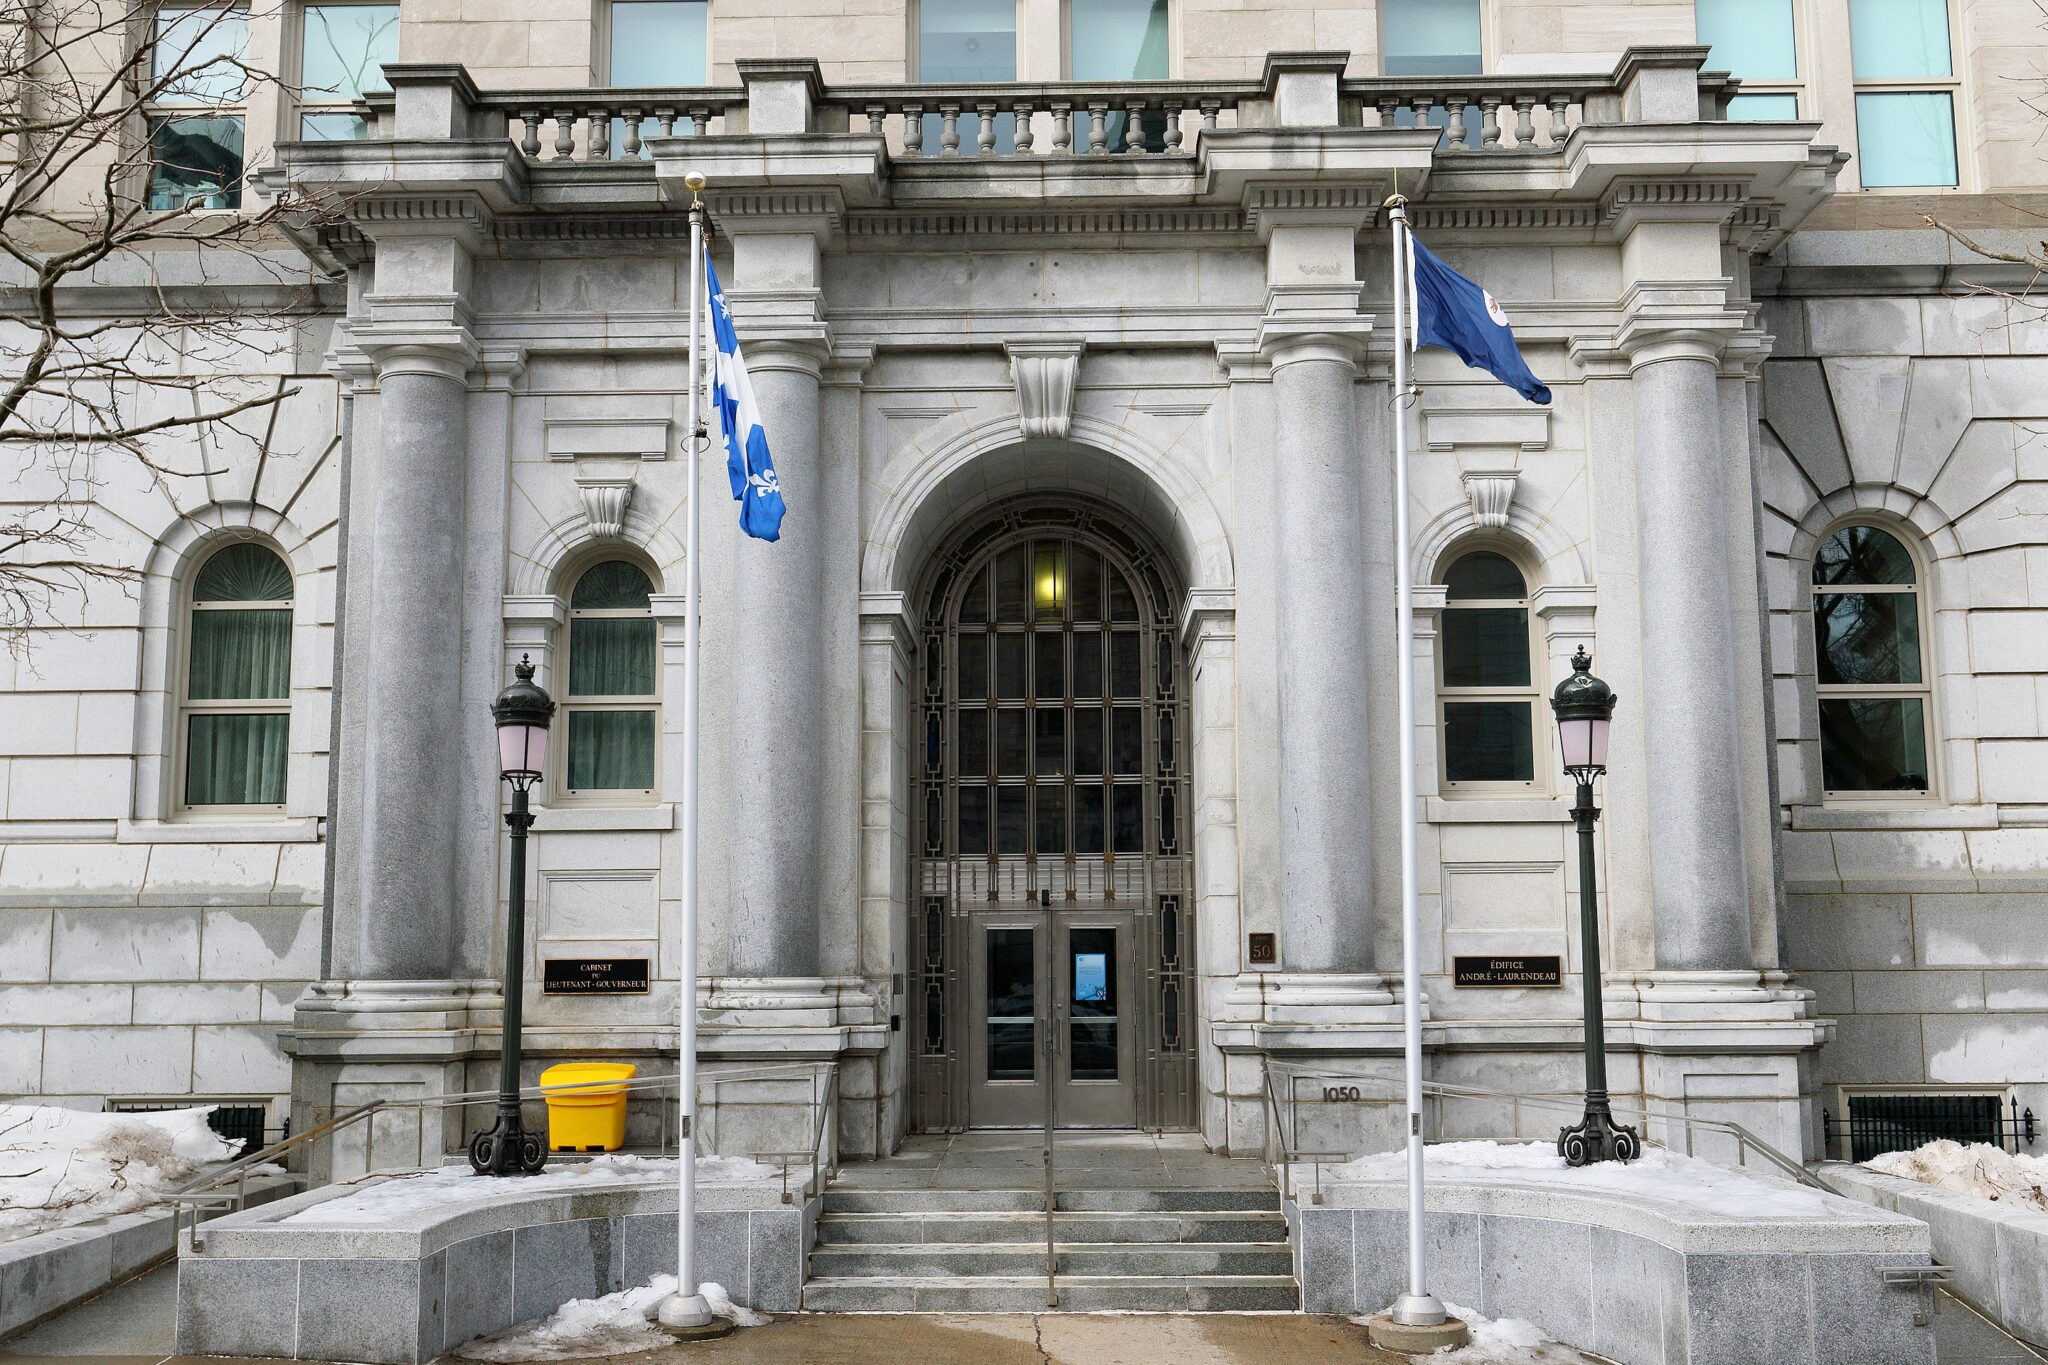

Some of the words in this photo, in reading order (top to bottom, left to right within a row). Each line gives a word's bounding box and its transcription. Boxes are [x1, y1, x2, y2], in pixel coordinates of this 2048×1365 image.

[1253, 944, 1270, 958] 50
[580, 964, 612, 972] CABINET
[1490, 959, 1524, 969] ÉDIFICE
[1322, 1086, 1361, 1102] 1050
